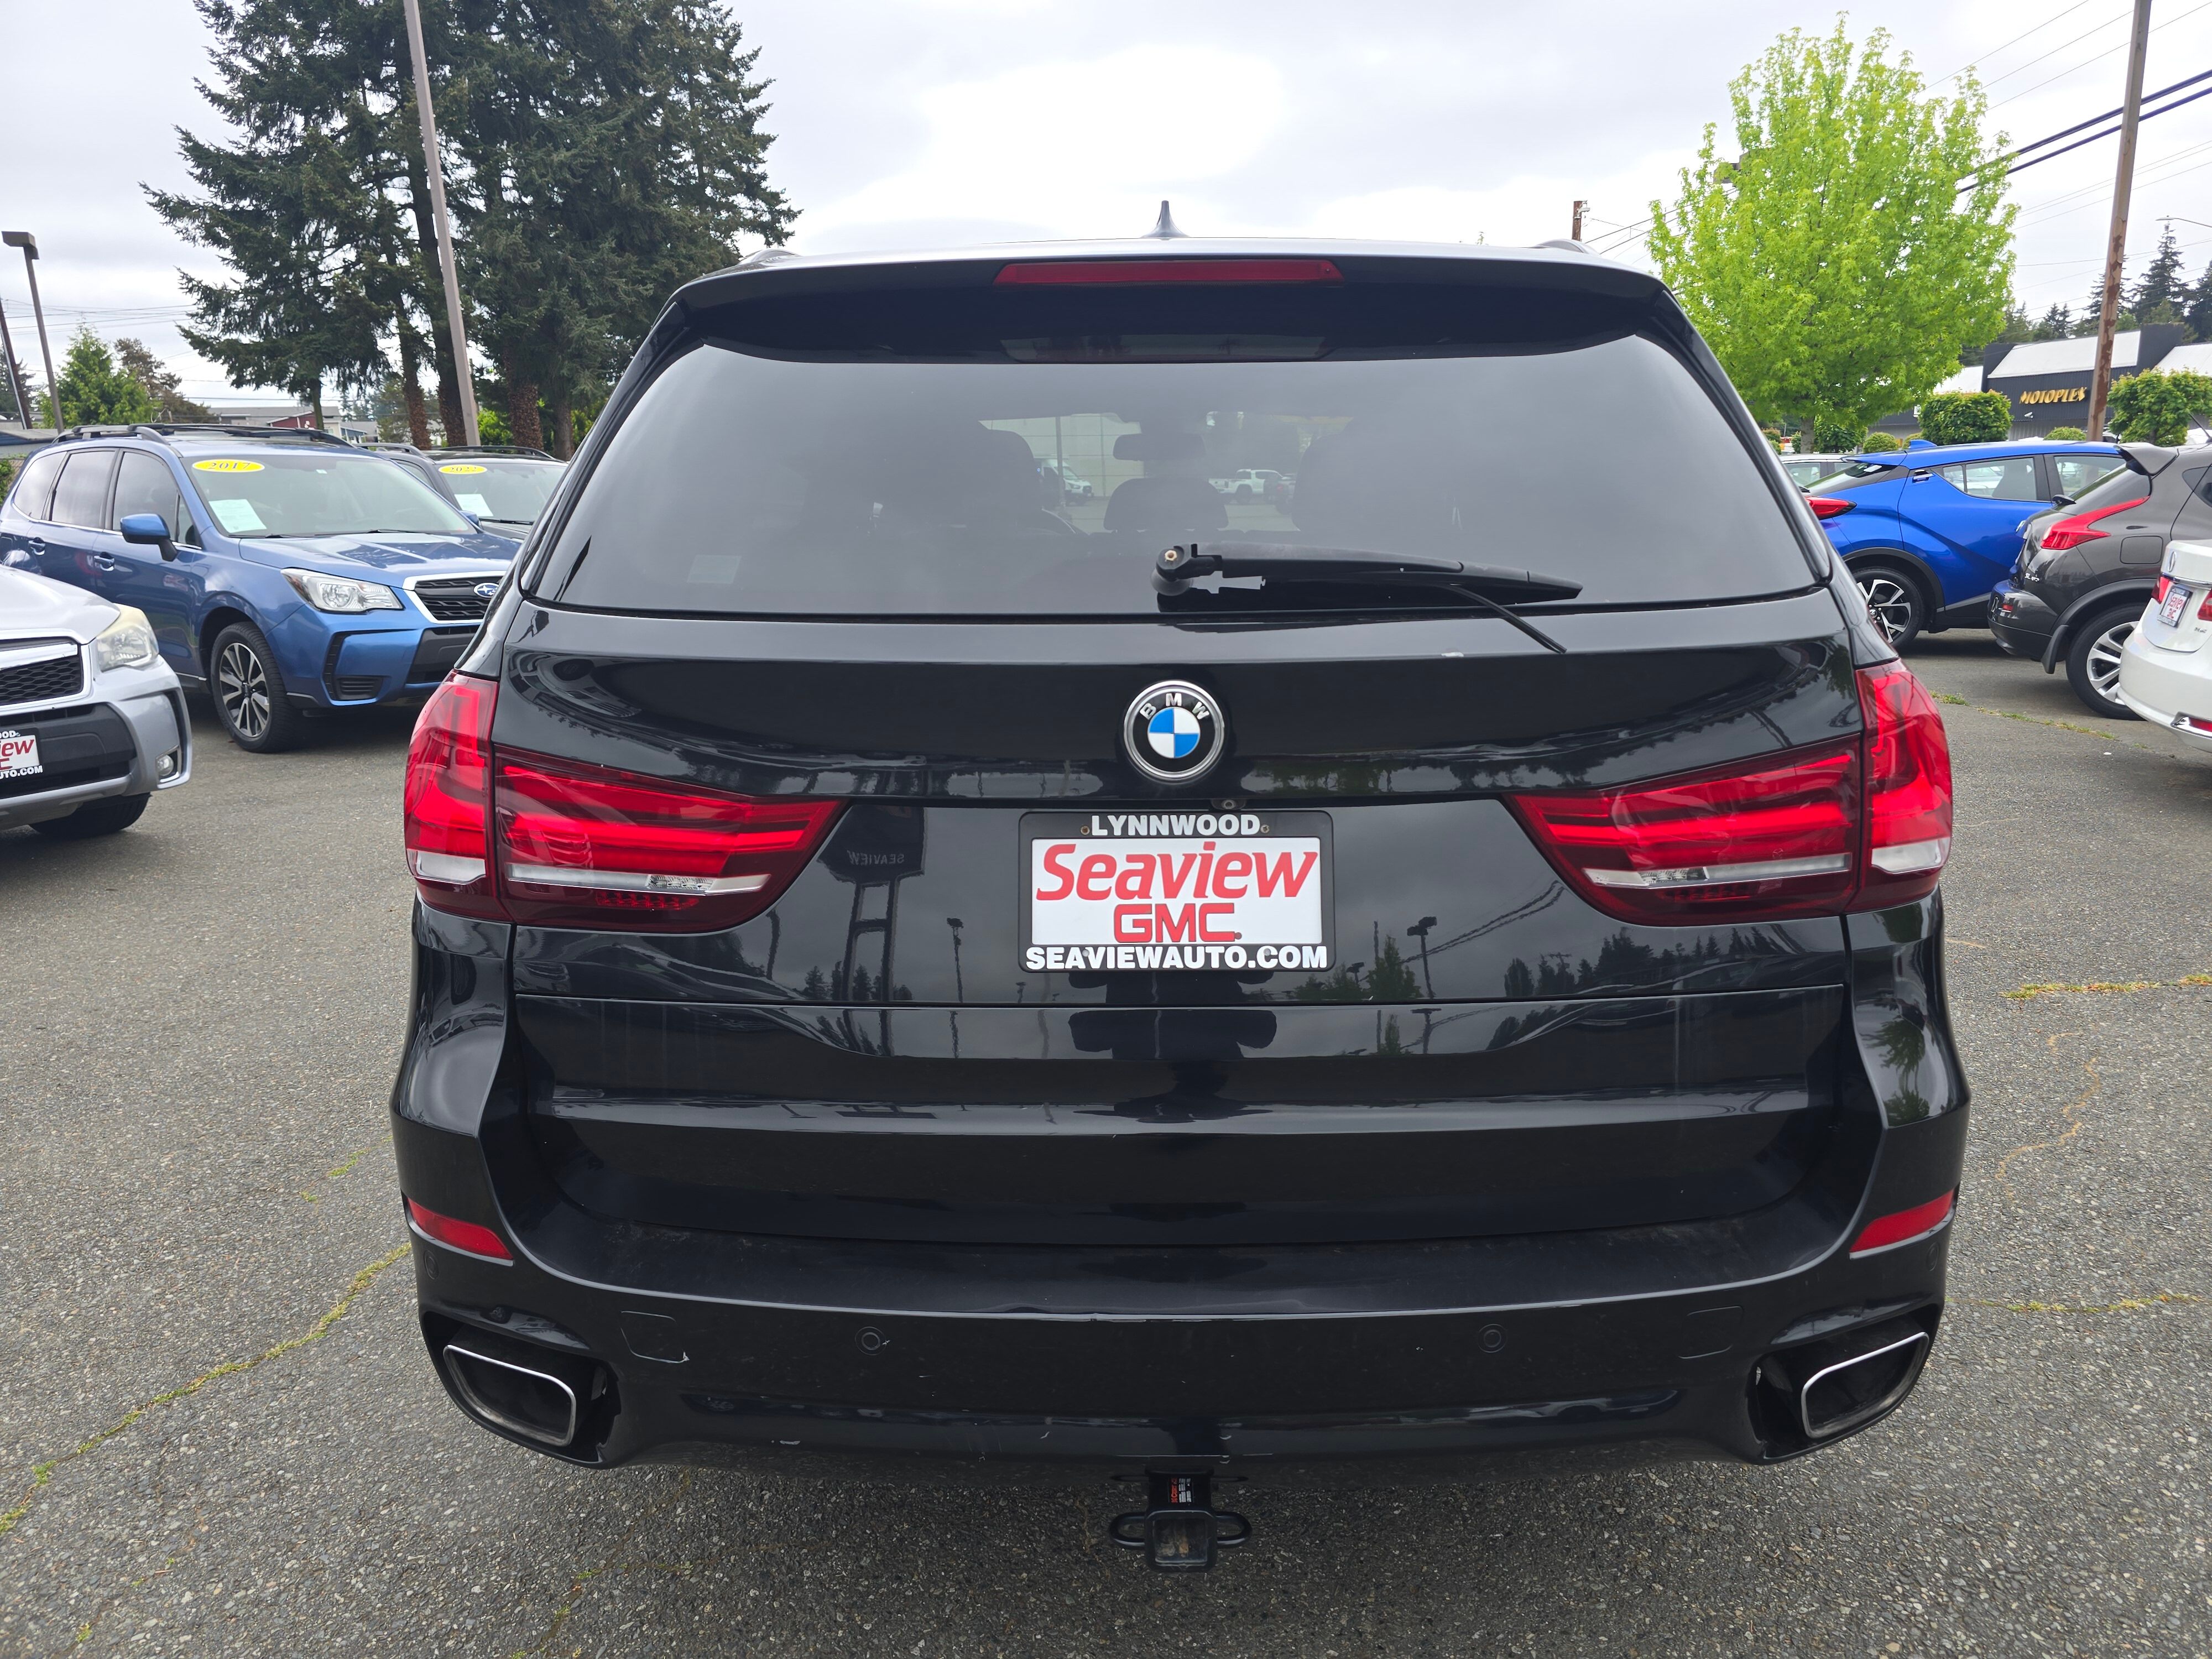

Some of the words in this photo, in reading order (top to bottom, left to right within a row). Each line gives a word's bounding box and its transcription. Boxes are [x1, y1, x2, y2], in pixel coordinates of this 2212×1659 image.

[2020, 387, 2087, 404] MOTOPLEX
[1139, 692, 1210, 720] BMW
[0, 730, 16, 739] OD
[0, 739, 34, 757] ew
[1091, 814, 1261, 837] LYNNWOOD
[1036, 841, 1318, 901] Seaview
[1113, 902, 1235, 943] GMC
[1026, 946, 1328, 970] SEAVIEWAUTO.COM
